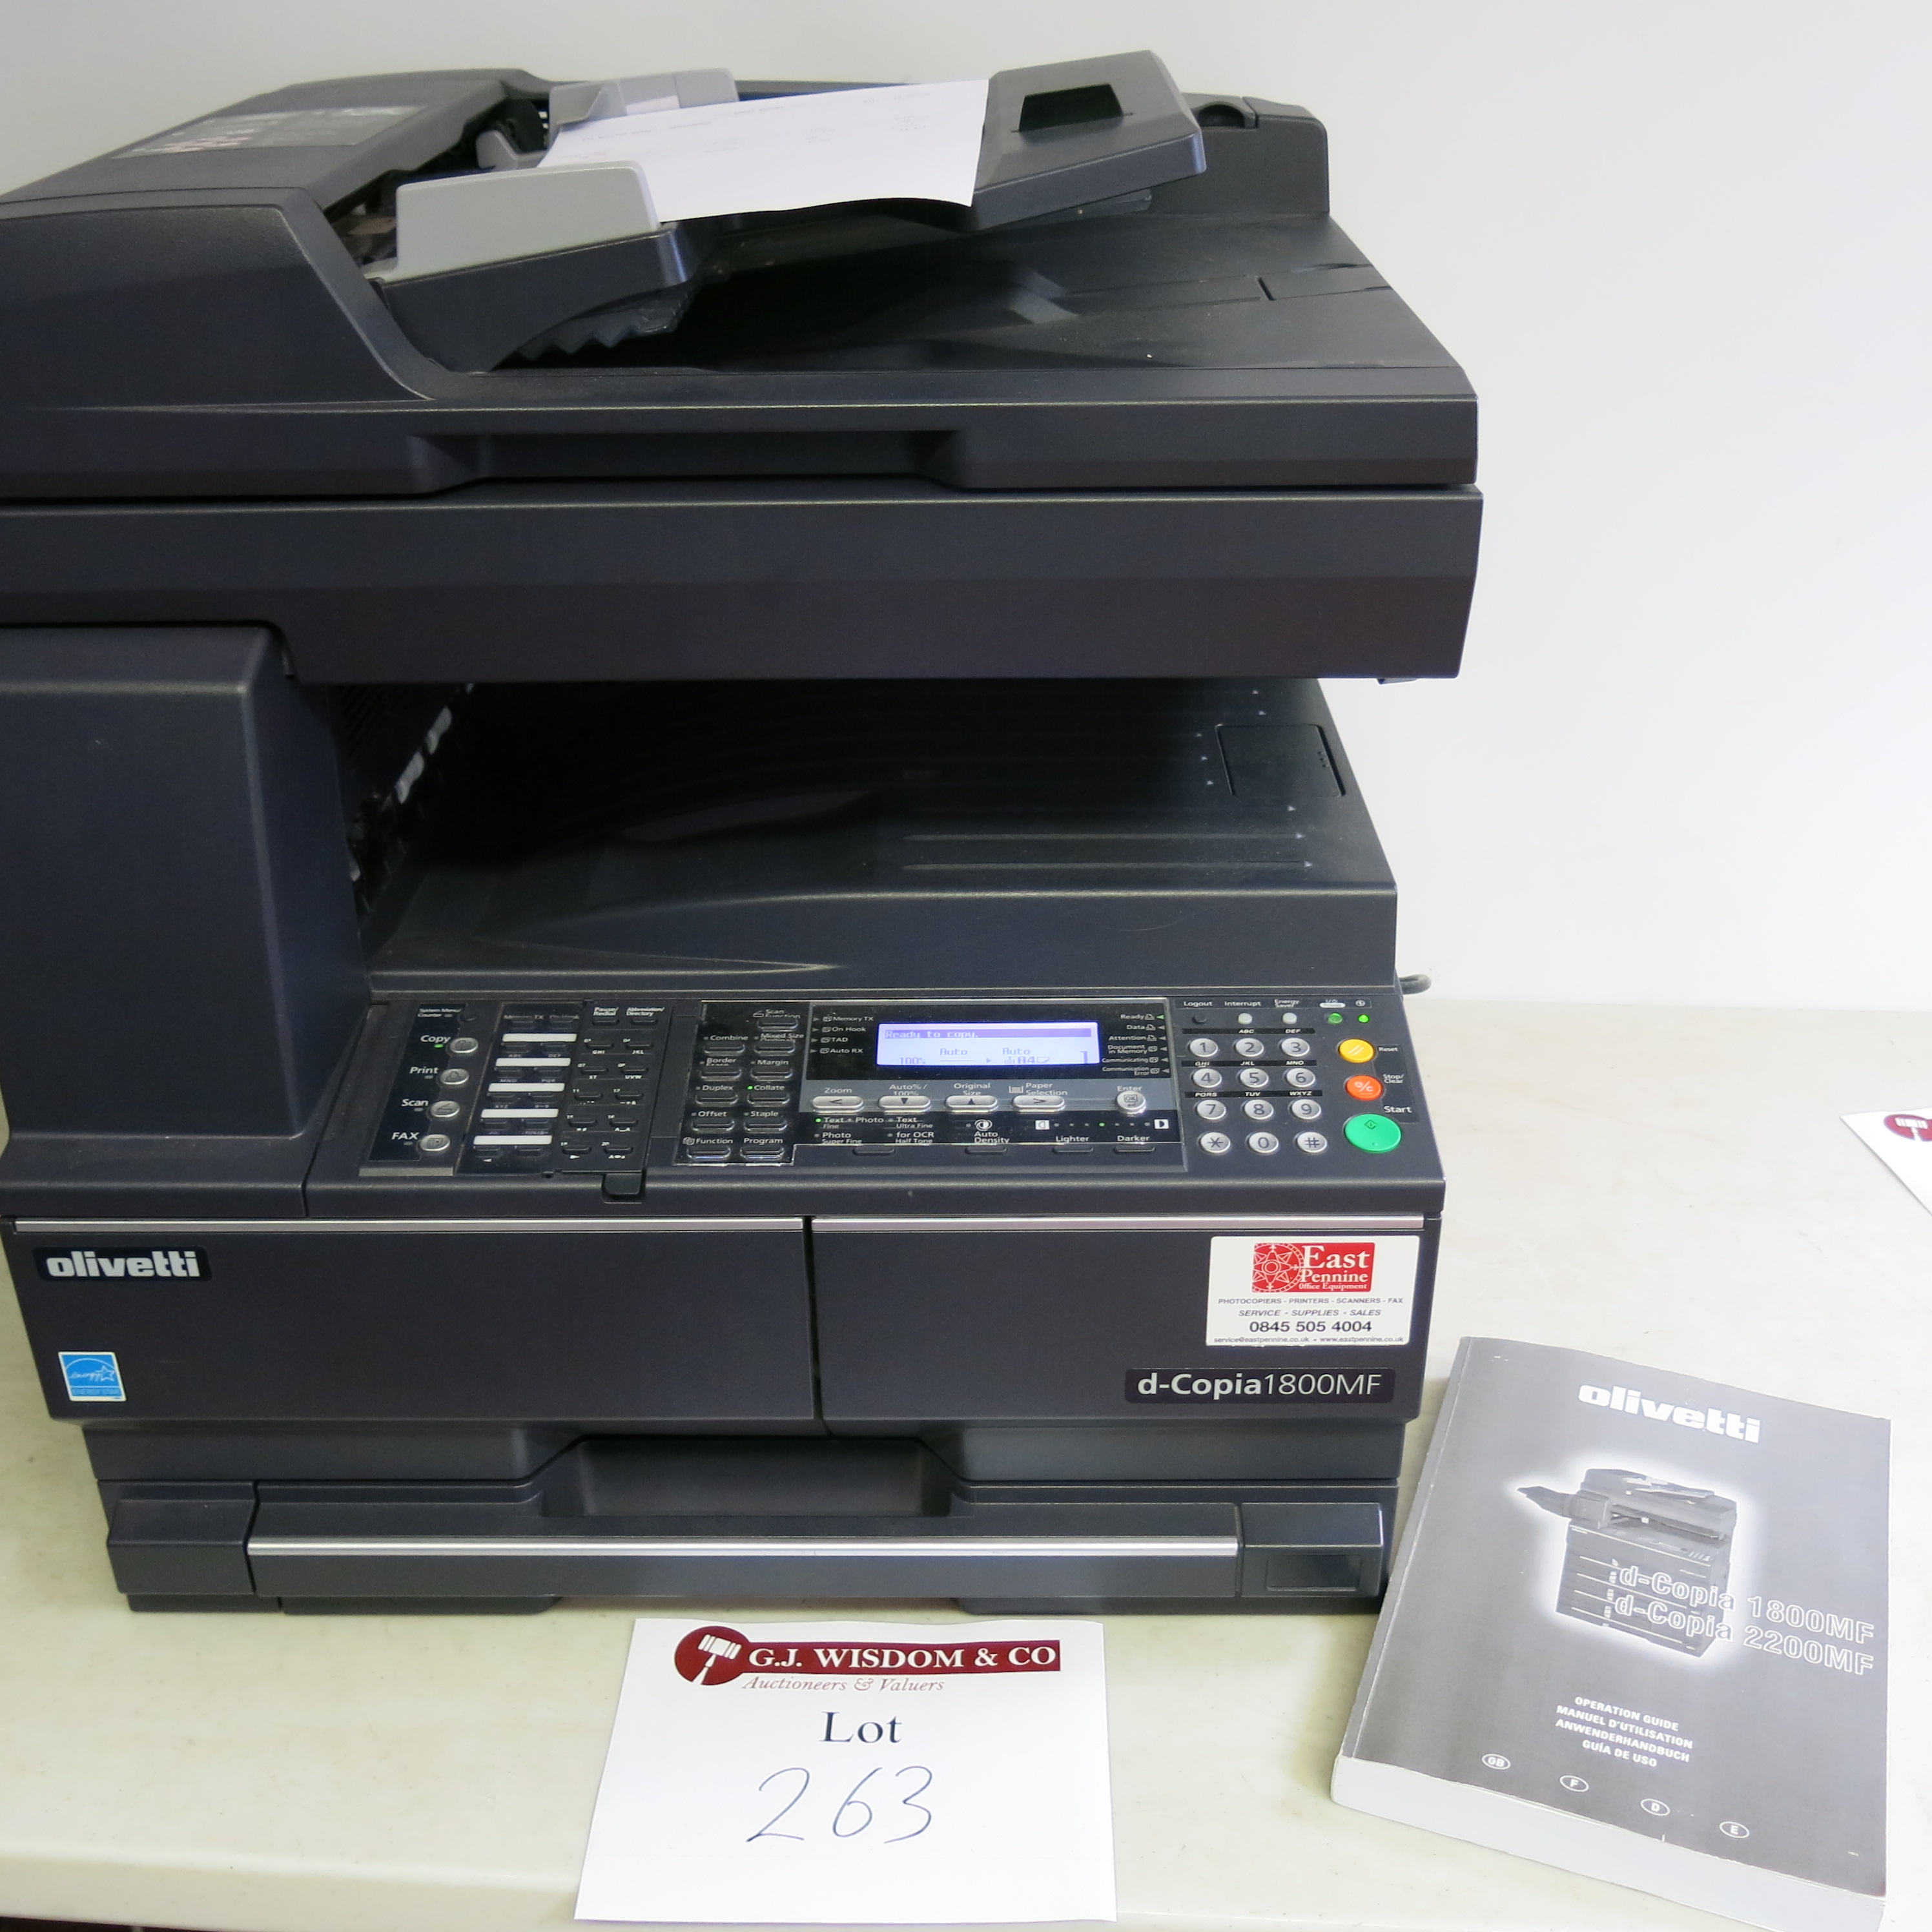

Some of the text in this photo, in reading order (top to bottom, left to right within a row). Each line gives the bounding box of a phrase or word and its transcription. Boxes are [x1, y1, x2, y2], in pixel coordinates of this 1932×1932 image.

[420, 1034, 451, 1044] Copy
[885, 1030, 920, 1039] Ready
[1198, 1042, 1207, 1053] 1
[1244, 1042, 1255, 1053] 2
[1291, 1042, 1301, 1053] 3
[899, 1056, 926, 1065] 100%
[1201, 1073, 1213, 1083] 4
[1249, 1073, 1259, 1084] 5
[1295, 1072, 1306, 1083] 6
[402, 1098, 429, 1107] Scan
[1206, 1104, 1217, 1115] 7
[1253, 1104, 1265, 1115] 8
[1300, 1103, 1312, 1115] 9
[391, 1132, 419, 1140] FAX
[1259, 1136, 1269, 1149] 0
[1302, 1245, 1371, 1269] East
[46, 1250, 201, 1277] olivetti
[1300, 1269, 1368, 1282] Pennine
[1322, 1282, 1368, 1291] Equipment
[1249, 1321, 1372, 1332] 0845 505 4004
[1578, 1384, 1762, 1444] olivetti
[1619, 1565, 1875, 1645] d-Copia 1800MF
[1614, 1594, 1874, 1676] d-Copia 2200MF
[748, 1645, 1057, 1669] G.J. WISDOM & CO
[741, 1676, 945, 1692] Auctioneers & Valuers
[1556, 1705, 1607, 1727] MANUEL
[1574, 1696, 1680, 1732] OPERATION GUIDE
[818, 1711, 903, 1744] Lot
[1555, 1719, 1690, 1763] ANWENDERHANDBUCH
[1582, 1738, 1658, 1768] GUÍA DE USO
[745, 1765, 933, 1844] 263
